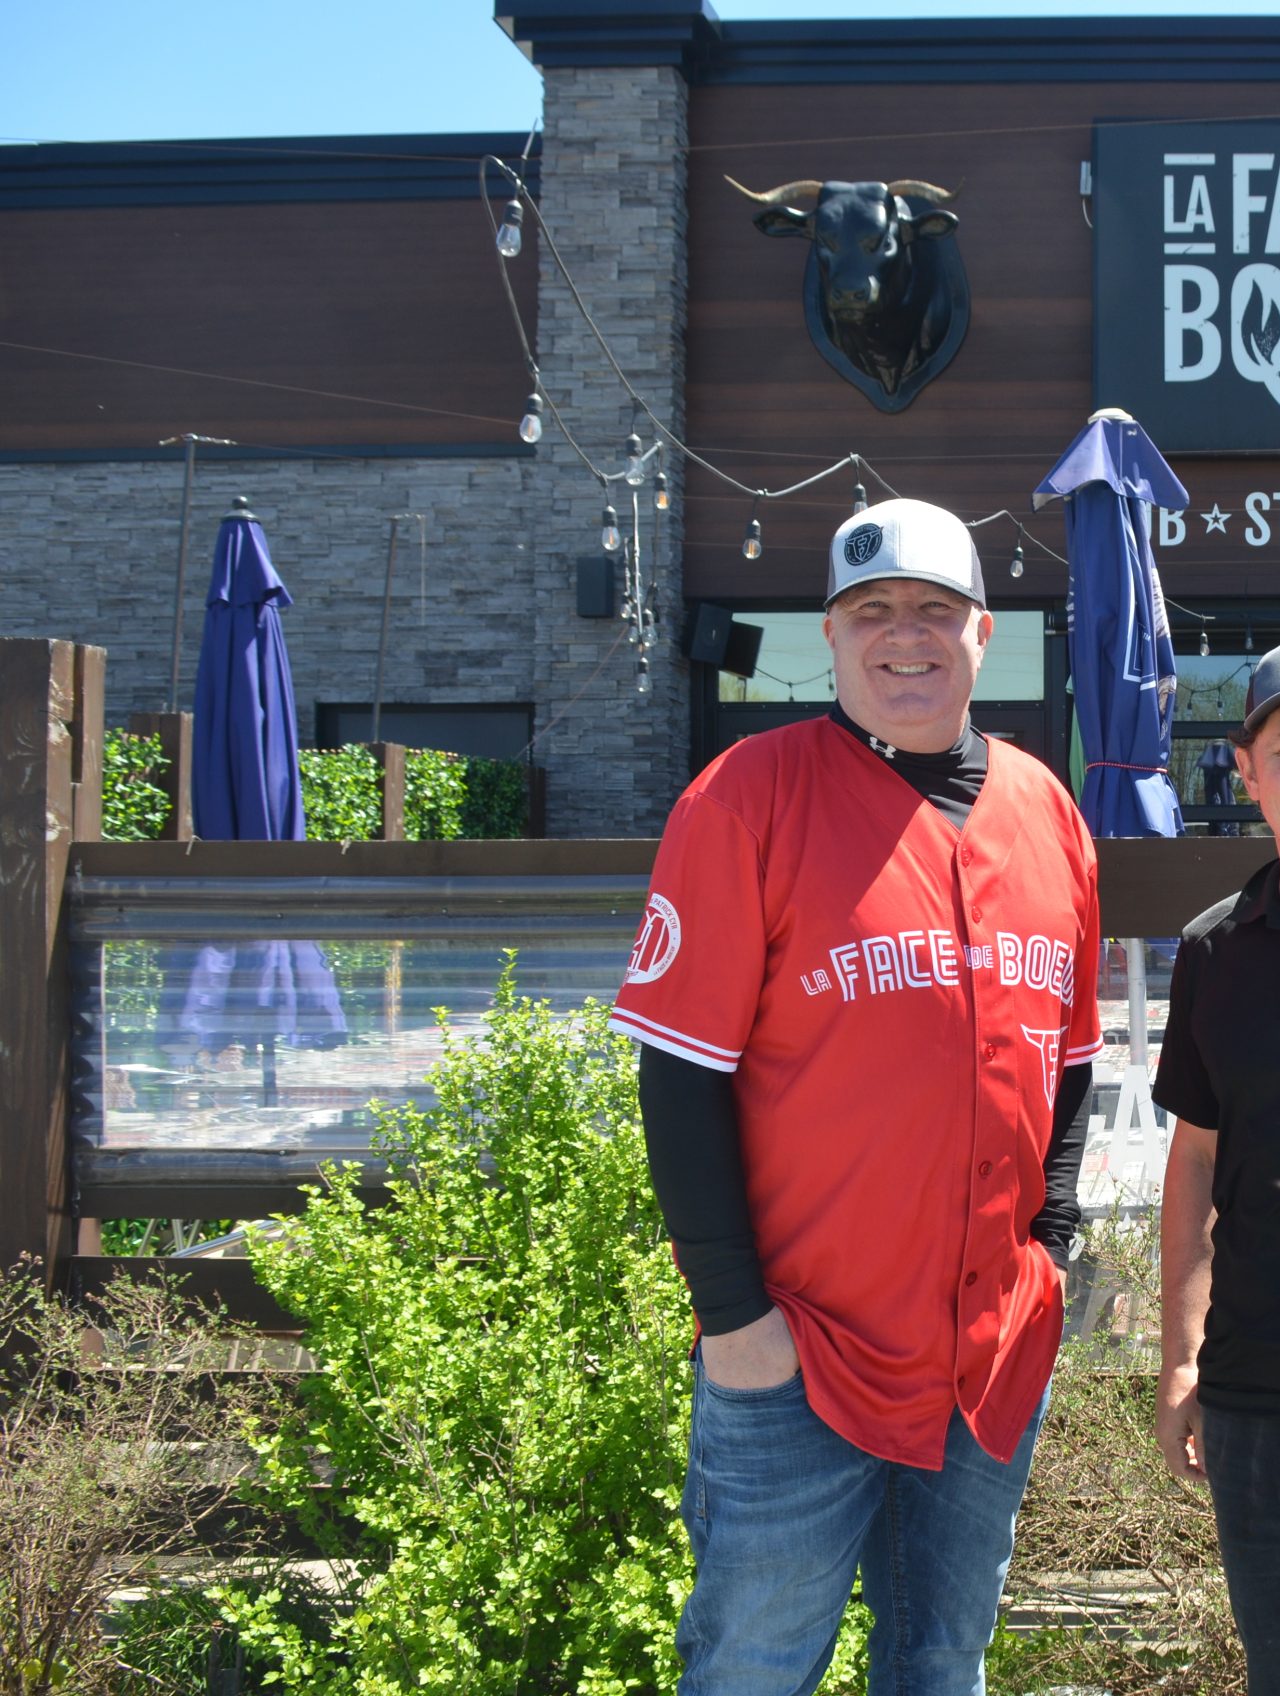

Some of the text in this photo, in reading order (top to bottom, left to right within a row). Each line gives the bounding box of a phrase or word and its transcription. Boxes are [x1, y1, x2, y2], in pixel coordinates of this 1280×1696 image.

[1164, 175, 1216, 233] LA
[652, 898, 674, 921] PATRICK
[800, 969, 832, 996] LA
[829, 929, 960, 1002] FACE
[964, 944, 993, 969] DE
